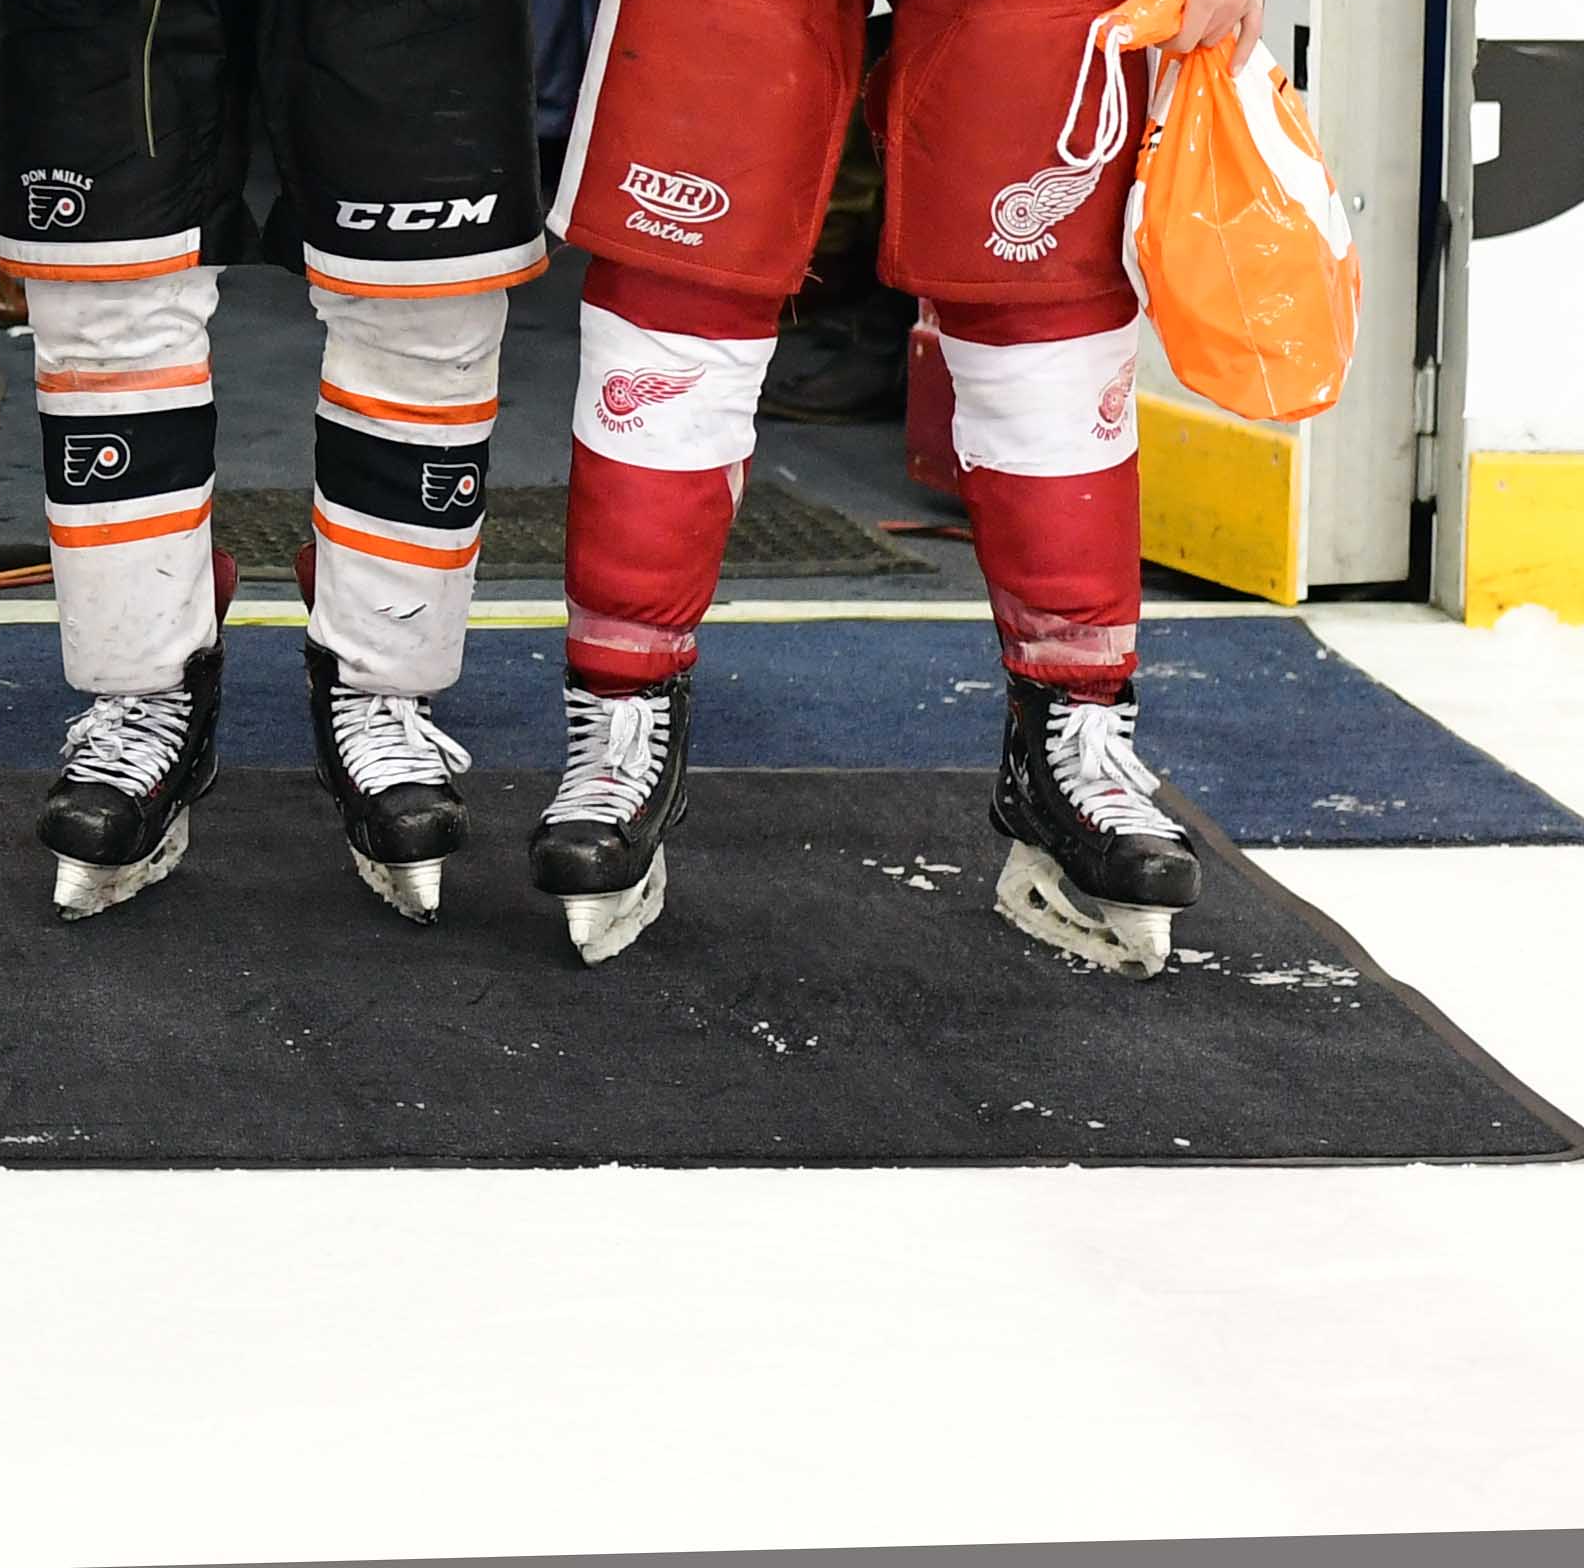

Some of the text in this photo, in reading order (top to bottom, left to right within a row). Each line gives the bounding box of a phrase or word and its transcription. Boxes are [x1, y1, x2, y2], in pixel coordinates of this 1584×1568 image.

[20, 168, 95, 191] DON MILLS
[335, 193, 499, 232] CCM
[625, 210, 705, 247] Custom
[984, 231, 1059, 263] TORONTO
[593, 400, 645, 434] TORONTO
